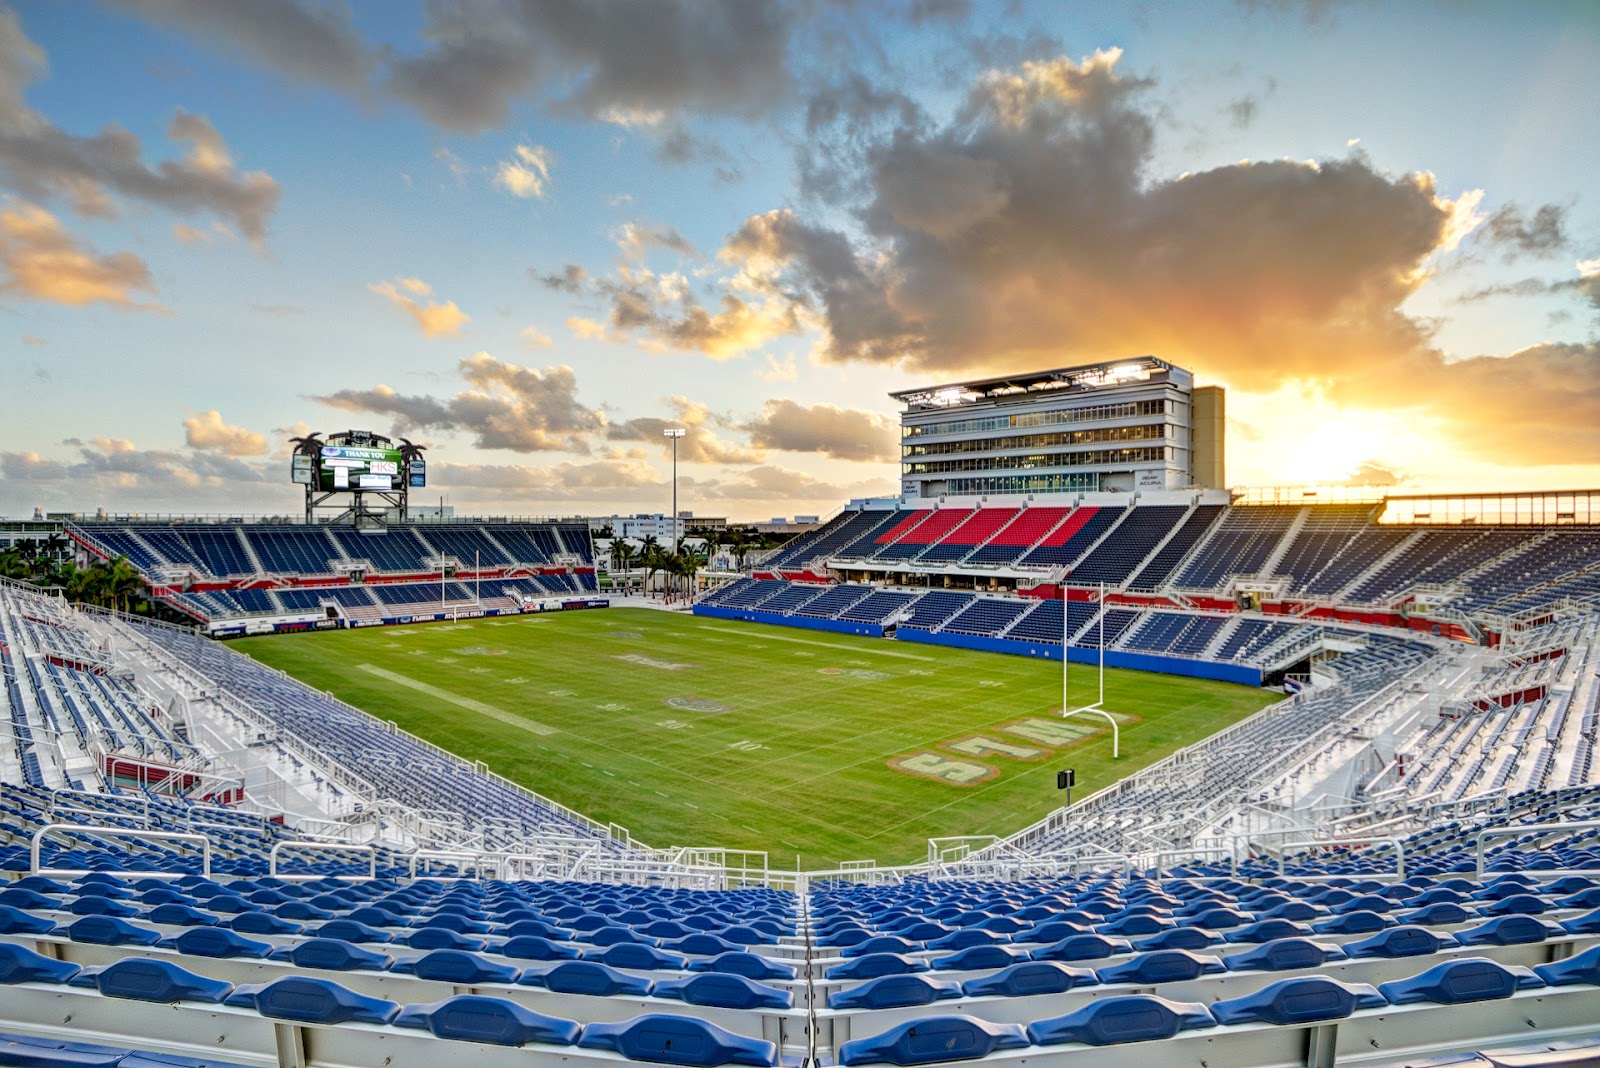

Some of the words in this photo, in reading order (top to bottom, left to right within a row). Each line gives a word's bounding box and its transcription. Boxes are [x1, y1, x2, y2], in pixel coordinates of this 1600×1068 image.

[345, 450, 370, 458] THANK
[371, 462, 396, 472] HKS
[411, 614, 435, 622] FLORIDA
